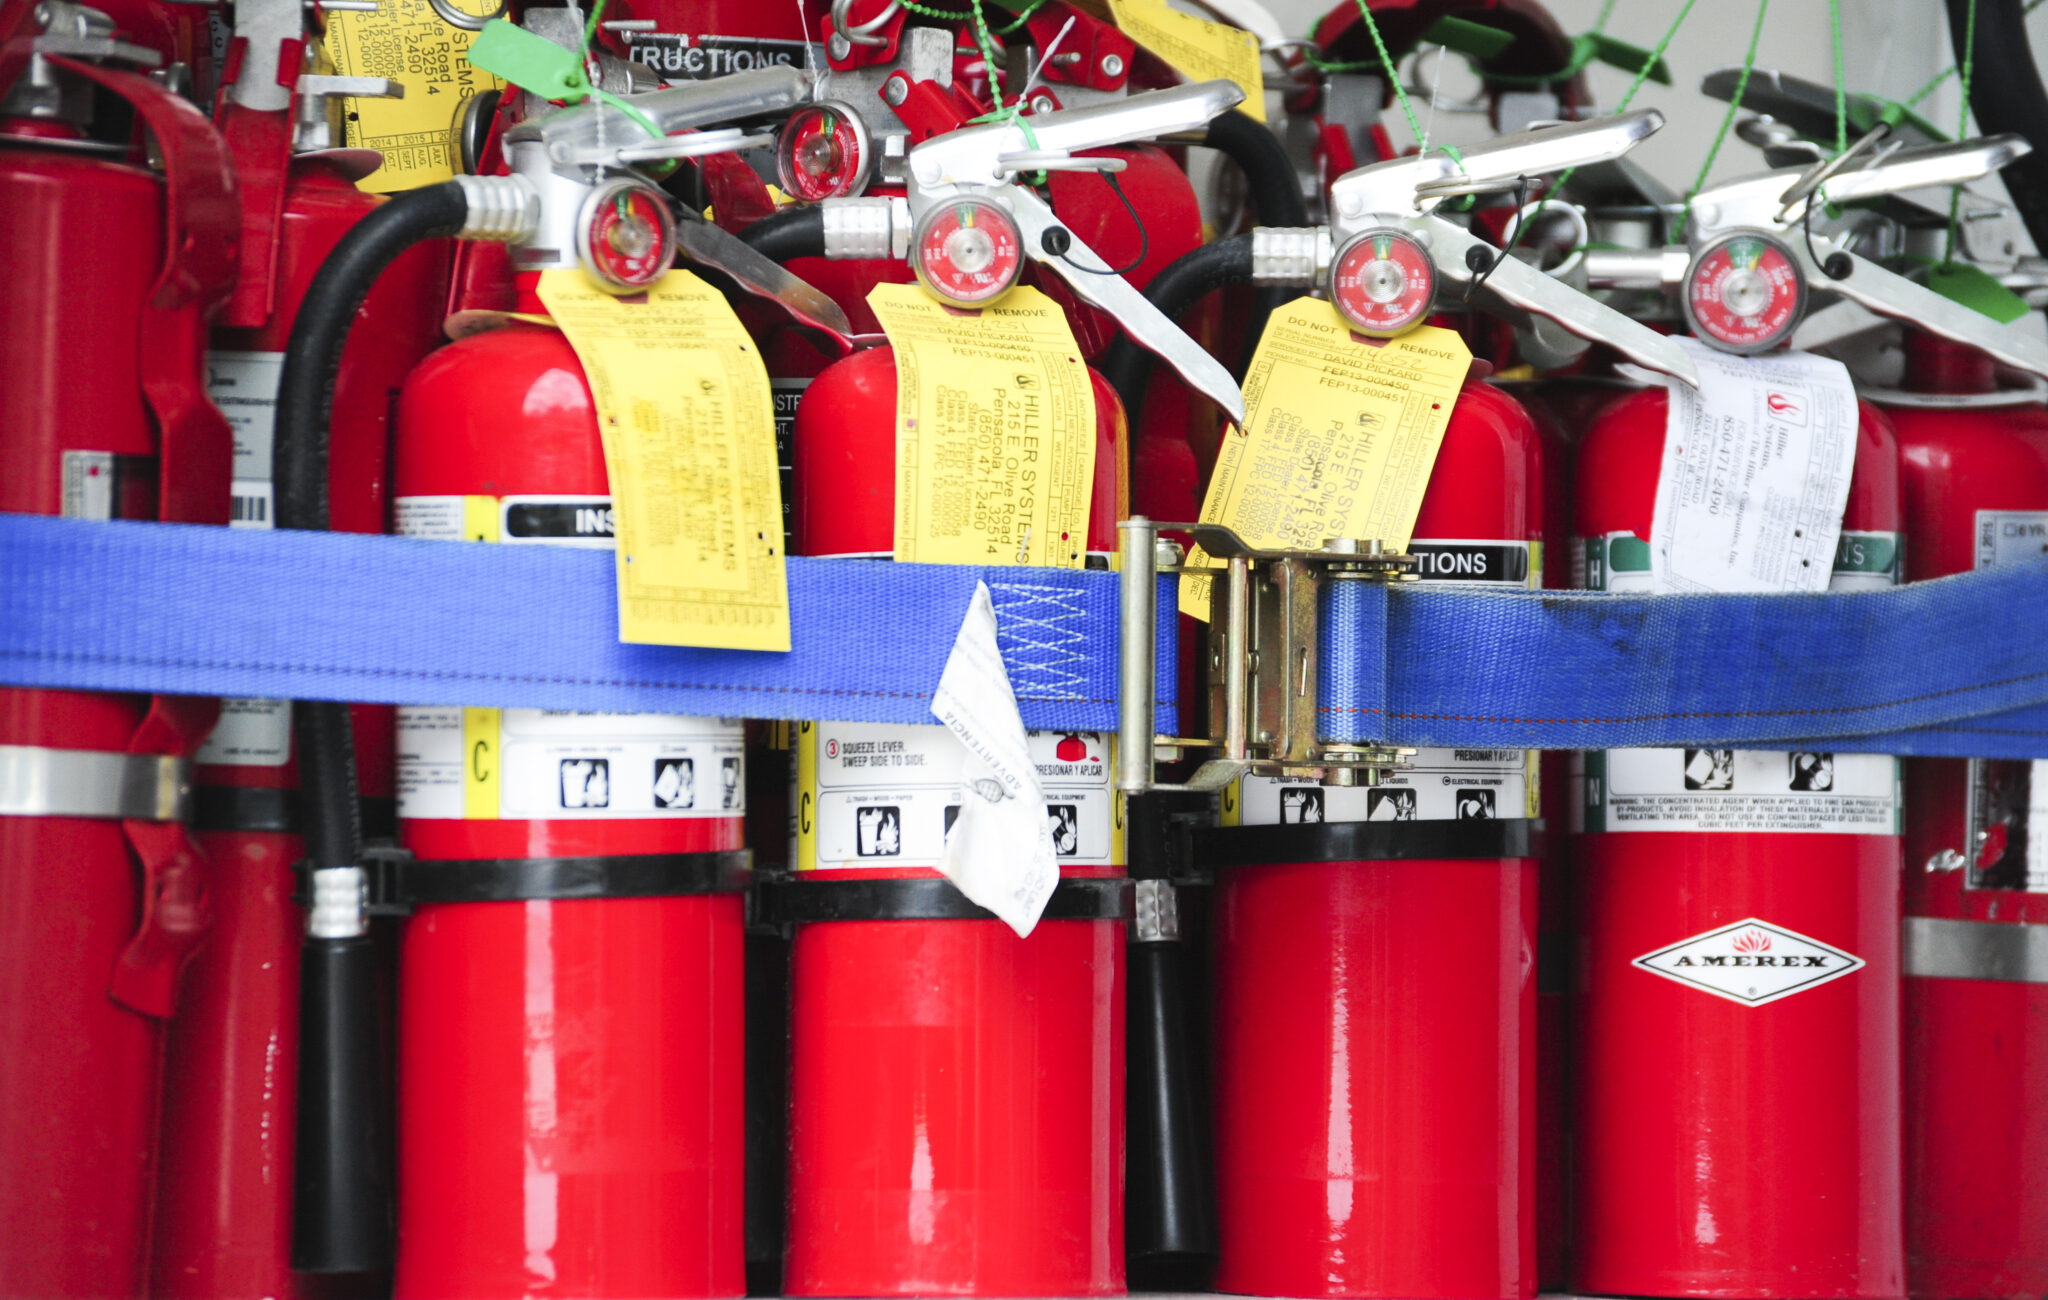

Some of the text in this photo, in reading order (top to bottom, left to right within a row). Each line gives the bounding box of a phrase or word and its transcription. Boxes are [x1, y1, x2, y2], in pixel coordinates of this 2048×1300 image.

[390, 26, 406, 72] License
[399, 0, 422, 74] 471-2490
[448, 6, 474, 99] STEMS
[417, 21, 440, 96] FL 32514
[436, 41, 453, 83] Road
[370, 131, 426, 148] 2014 2015
[432, 147, 442, 165] JULY
[993, 308, 1049, 318] REMOVE
[936, 326, 977, 339] DAVID
[1287, 316, 1456, 361] DO NOT REMOVE
[952, 346, 1035, 364] FEP13-000451
[1322, 352, 1424, 382] DAVID PICKARD
[1319, 377, 1405, 404] FEP13-000451
[1322, 365, 1410, 392] FEP13-000450
[934, 383, 946, 418] Class
[945, 388, 956, 422] Class
[955, 389, 967, 423] Class
[1007, 400, 1020, 430] 215
[1263, 406, 1282, 436] Class
[903, 442, 913, 464] NEW
[944, 441, 954, 467] FED
[954, 441, 964, 469] FED
[1225, 443, 1237, 463] NEW
[1332, 431, 1354, 460] 215
[1748, 440, 1758, 458] The
[1757, 421, 1776, 472] Systems,
[1774, 426, 1789, 460] Hiller
[962, 402, 978, 526] State Dealer License
[973, 408, 992, 530] (850) 471-2490
[1003, 456, 1018, 498] Olive
[1013, 394, 1040, 566] HILLER SYSTEMS
[1052, 440, 1063, 488] WET AGENT
[1064, 446, 1074, 486] POWDER
[1074, 456, 1086, 506] CARTRIDGE
[1240, 411, 1292, 537] Class FED 12-000059
[1248, 454, 1265, 480] FPC
[1250, 413, 1302, 541] Class FED 12-000058
[1264, 426, 1310, 535] State Dealer License
[1297, 418, 1343, 517] Pensacola, FL
[1689, 443, 1708, 504] OLIVE ROAD
[1707, 414, 1735, 516] 850-471-2490
[1720, 419, 1747, 519] FOR SERVICE CALL
[1742, 458, 1755, 488] Hiller
[988, 479, 1001, 499] FL
[1062, 487, 1071, 511] PUMP
[1205, 466, 1231, 522] MAINTENANCE
[1275, 433, 1323, 541] (850) 471-2490
[1312, 479, 1338, 519] Olive
[1324, 429, 1376, 540] HILLER SYST
[900, 469, 913, 535] MAINTENANCE
[985, 505, 1001, 554] 32514
[1001, 502, 1015, 545] Road
[1302, 519, 1324, 551] Roa
[1413, 551, 1488, 574] TIONS
[1726, 550, 1738, 570] Inc.
[474, 741, 489, 782] C
[843, 741, 875, 754] SQUEEZE
[878, 741, 906, 753] LEVER.
[843, 754, 928, 768] SWEEP SIDE TO SIDE.
[1454, 750, 1519, 762] PRESIONAR APLICAR
[1034, 764, 1103, 776] PRESIONAR APLICAR
[801, 792, 810, 834] C
[1779, 798, 1811, 806] APPLIED
[1673, 955, 1829, 968] AMEREX
